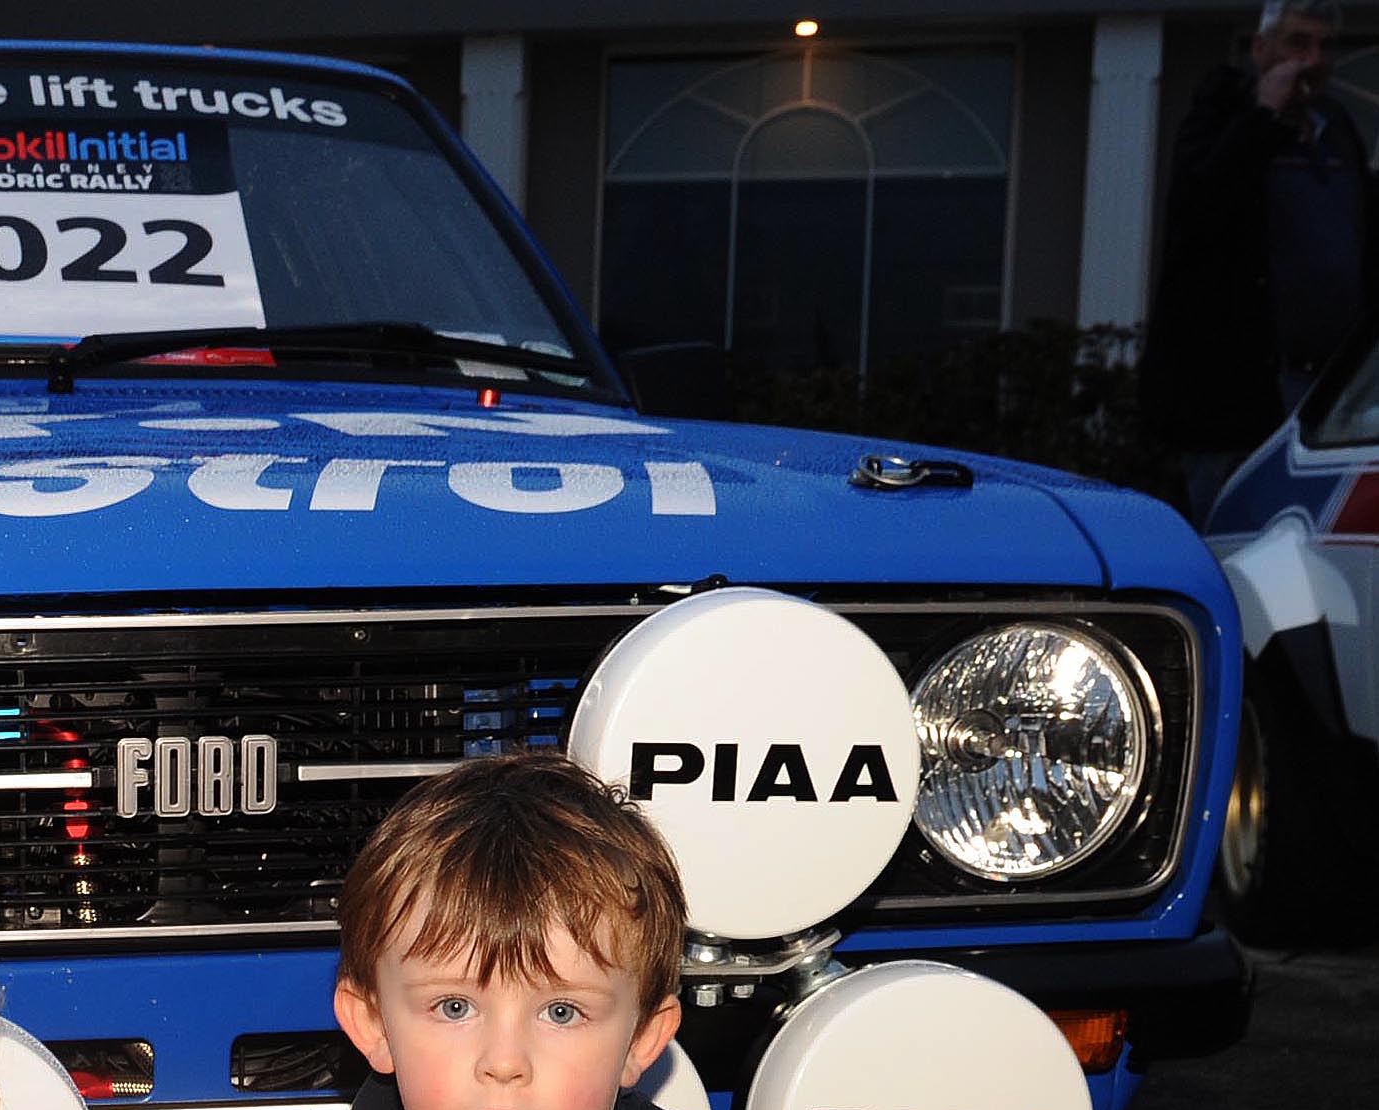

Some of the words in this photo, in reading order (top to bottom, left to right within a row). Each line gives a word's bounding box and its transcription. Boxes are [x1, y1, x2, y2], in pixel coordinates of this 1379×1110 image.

[29, 74, 117, 110] lift
[133, 79, 348, 128] trucks
[70, 173, 154, 190] RALLY
[117, 735, 278, 818] FORD
[628, 742, 901, 803] PIAA
